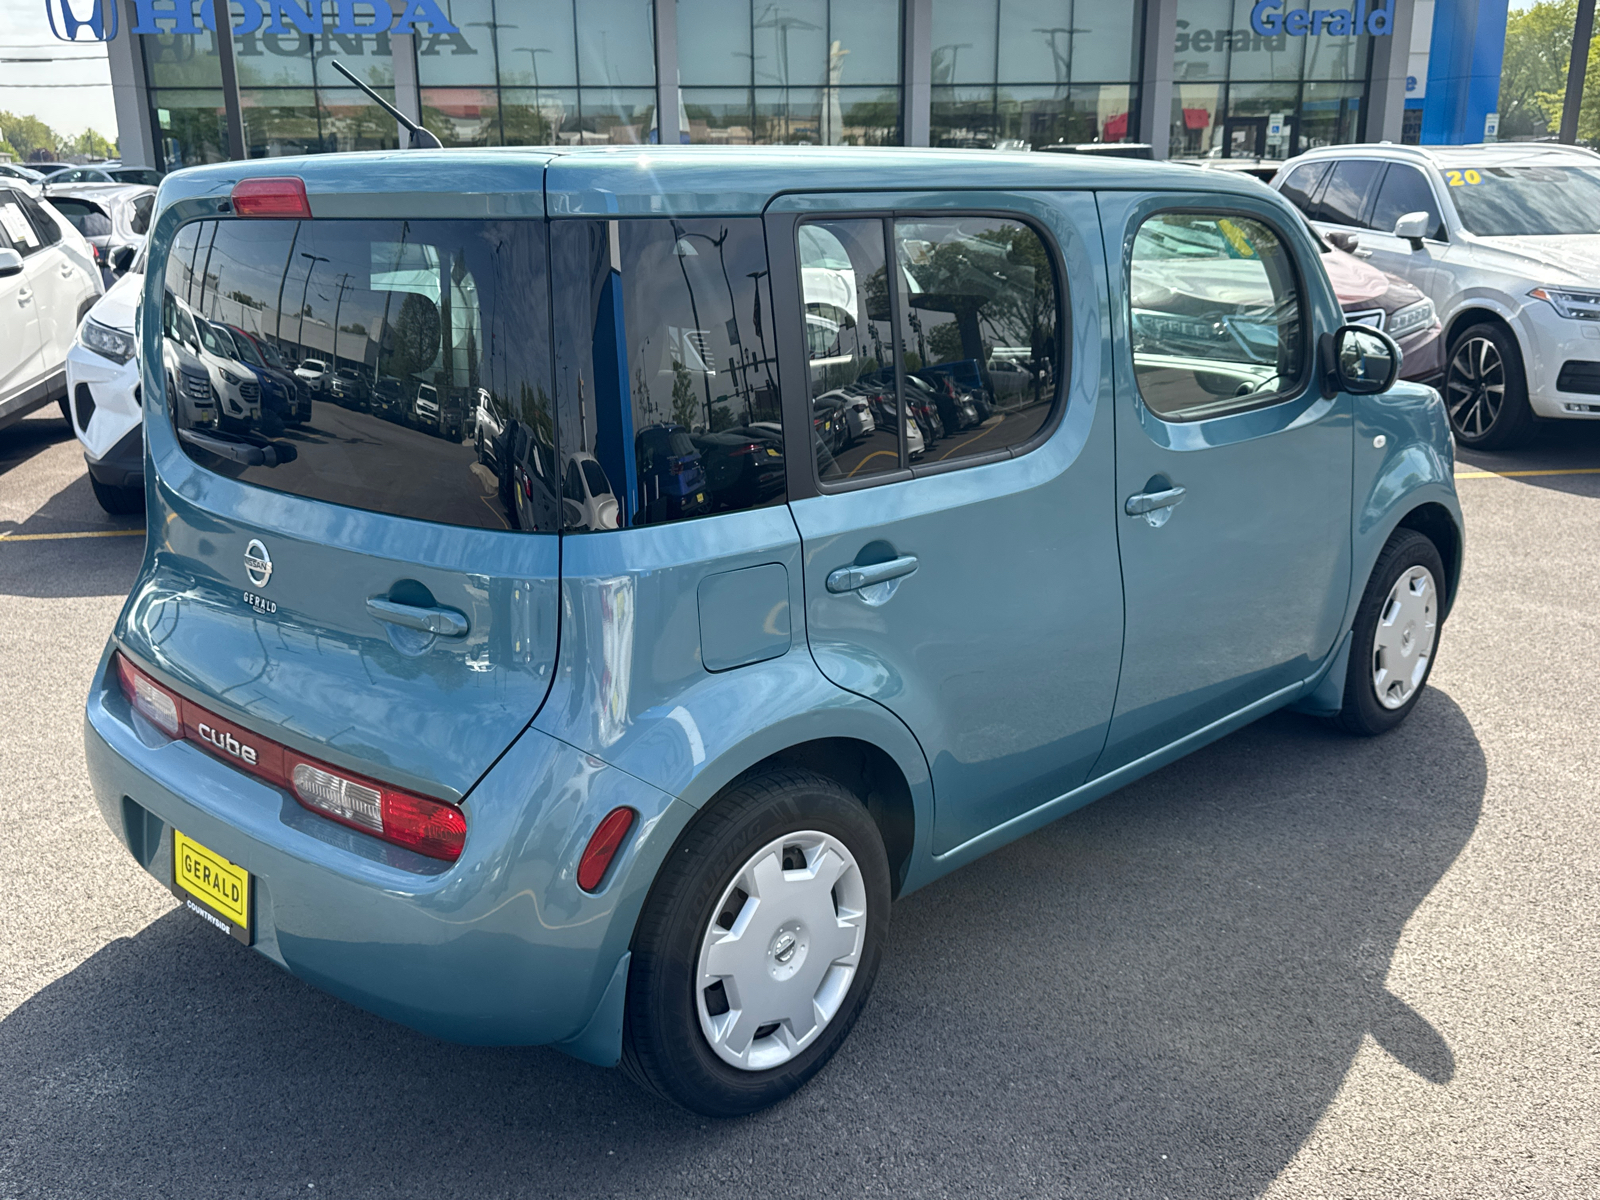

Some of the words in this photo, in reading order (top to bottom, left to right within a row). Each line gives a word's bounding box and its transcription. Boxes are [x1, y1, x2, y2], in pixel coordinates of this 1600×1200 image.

[132, 0, 459, 35] HONDA
[1251, 0, 1394, 36] Gerald
[1446, 170, 1481, 186] 20
[243, 592, 277, 613] GERALD
[199, 723, 258, 765] cube
[185, 854, 240, 902] GERALD
[187, 900, 231, 935] COUNTRYSIDE
